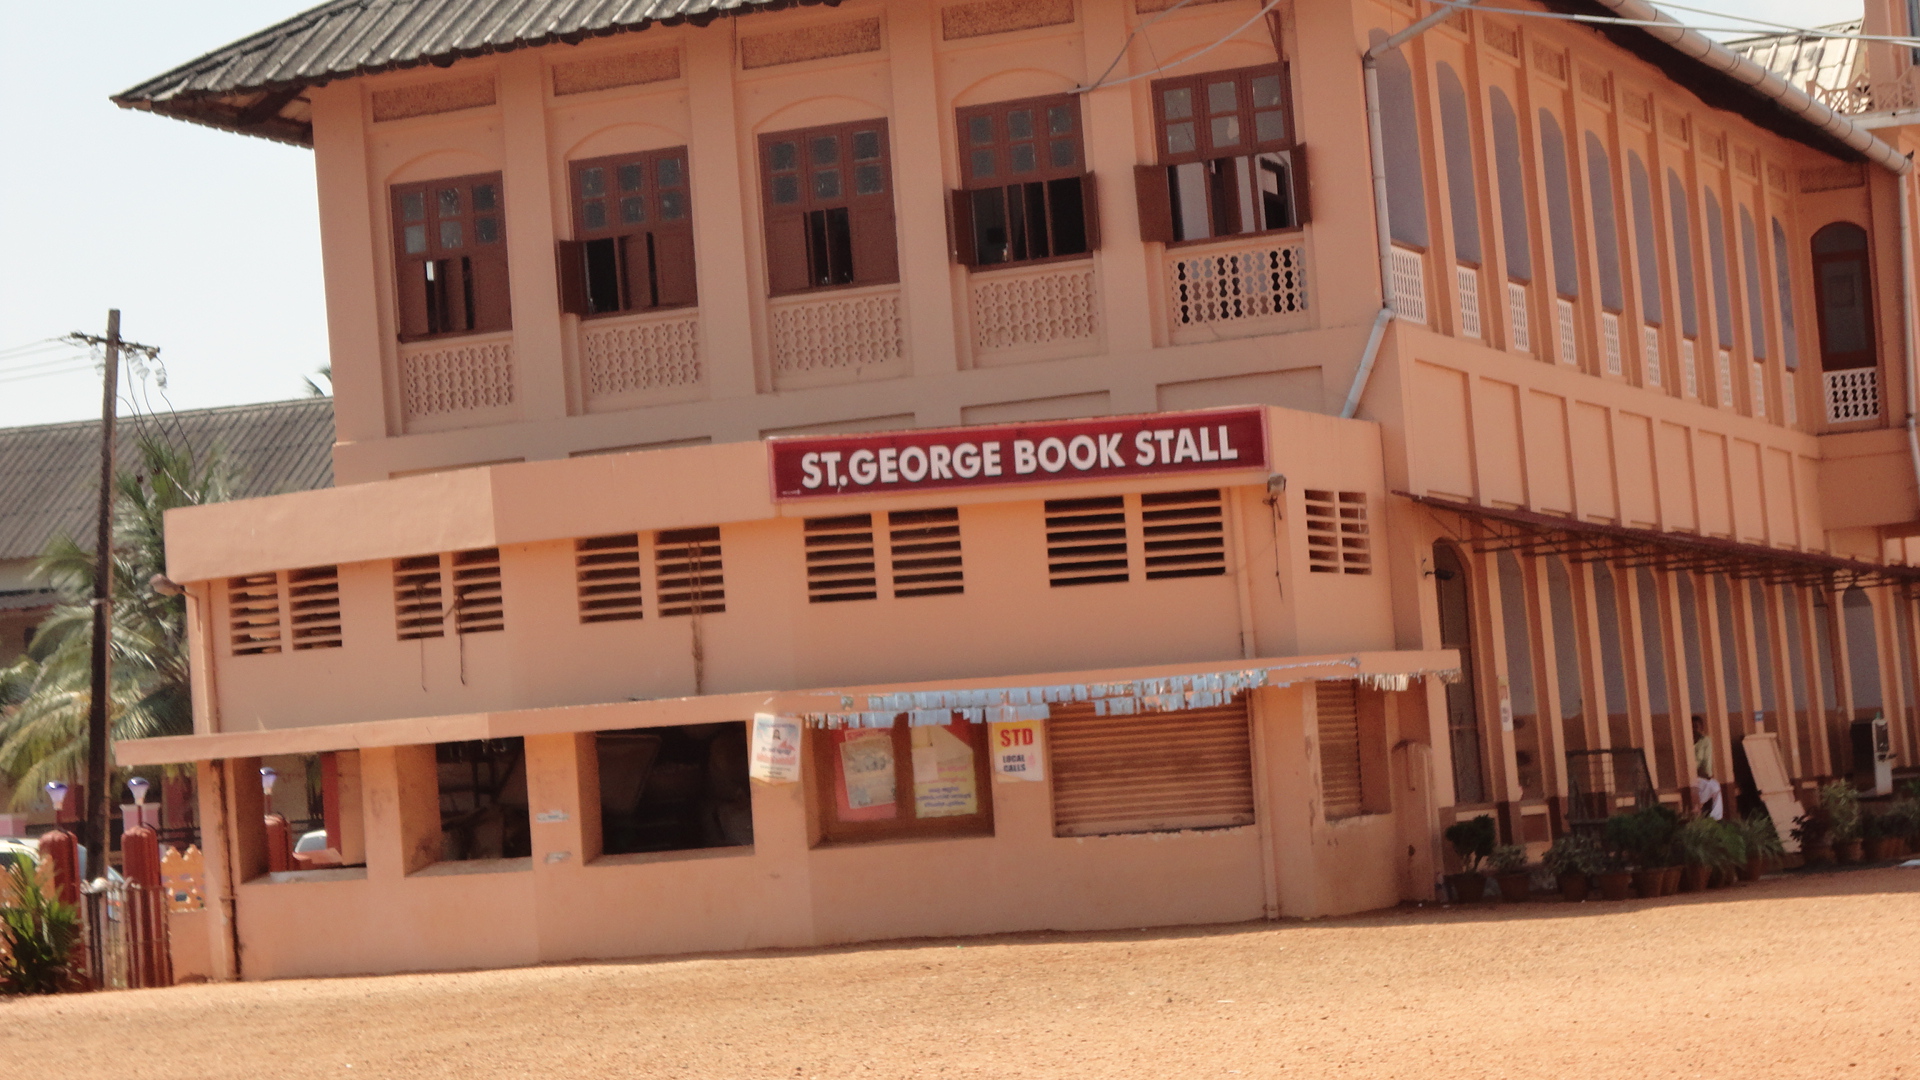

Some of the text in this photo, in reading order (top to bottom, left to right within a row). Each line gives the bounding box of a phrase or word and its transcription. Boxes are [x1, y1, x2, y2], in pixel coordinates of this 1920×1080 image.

[1013, 433, 1126, 475] BOOK
[1135, 425, 1238, 466] STALL
[1000, 728, 1033, 747] STD
[1002, 754, 1025, 763] LOCAL
[1003, 763, 1026, 772] CALLS
